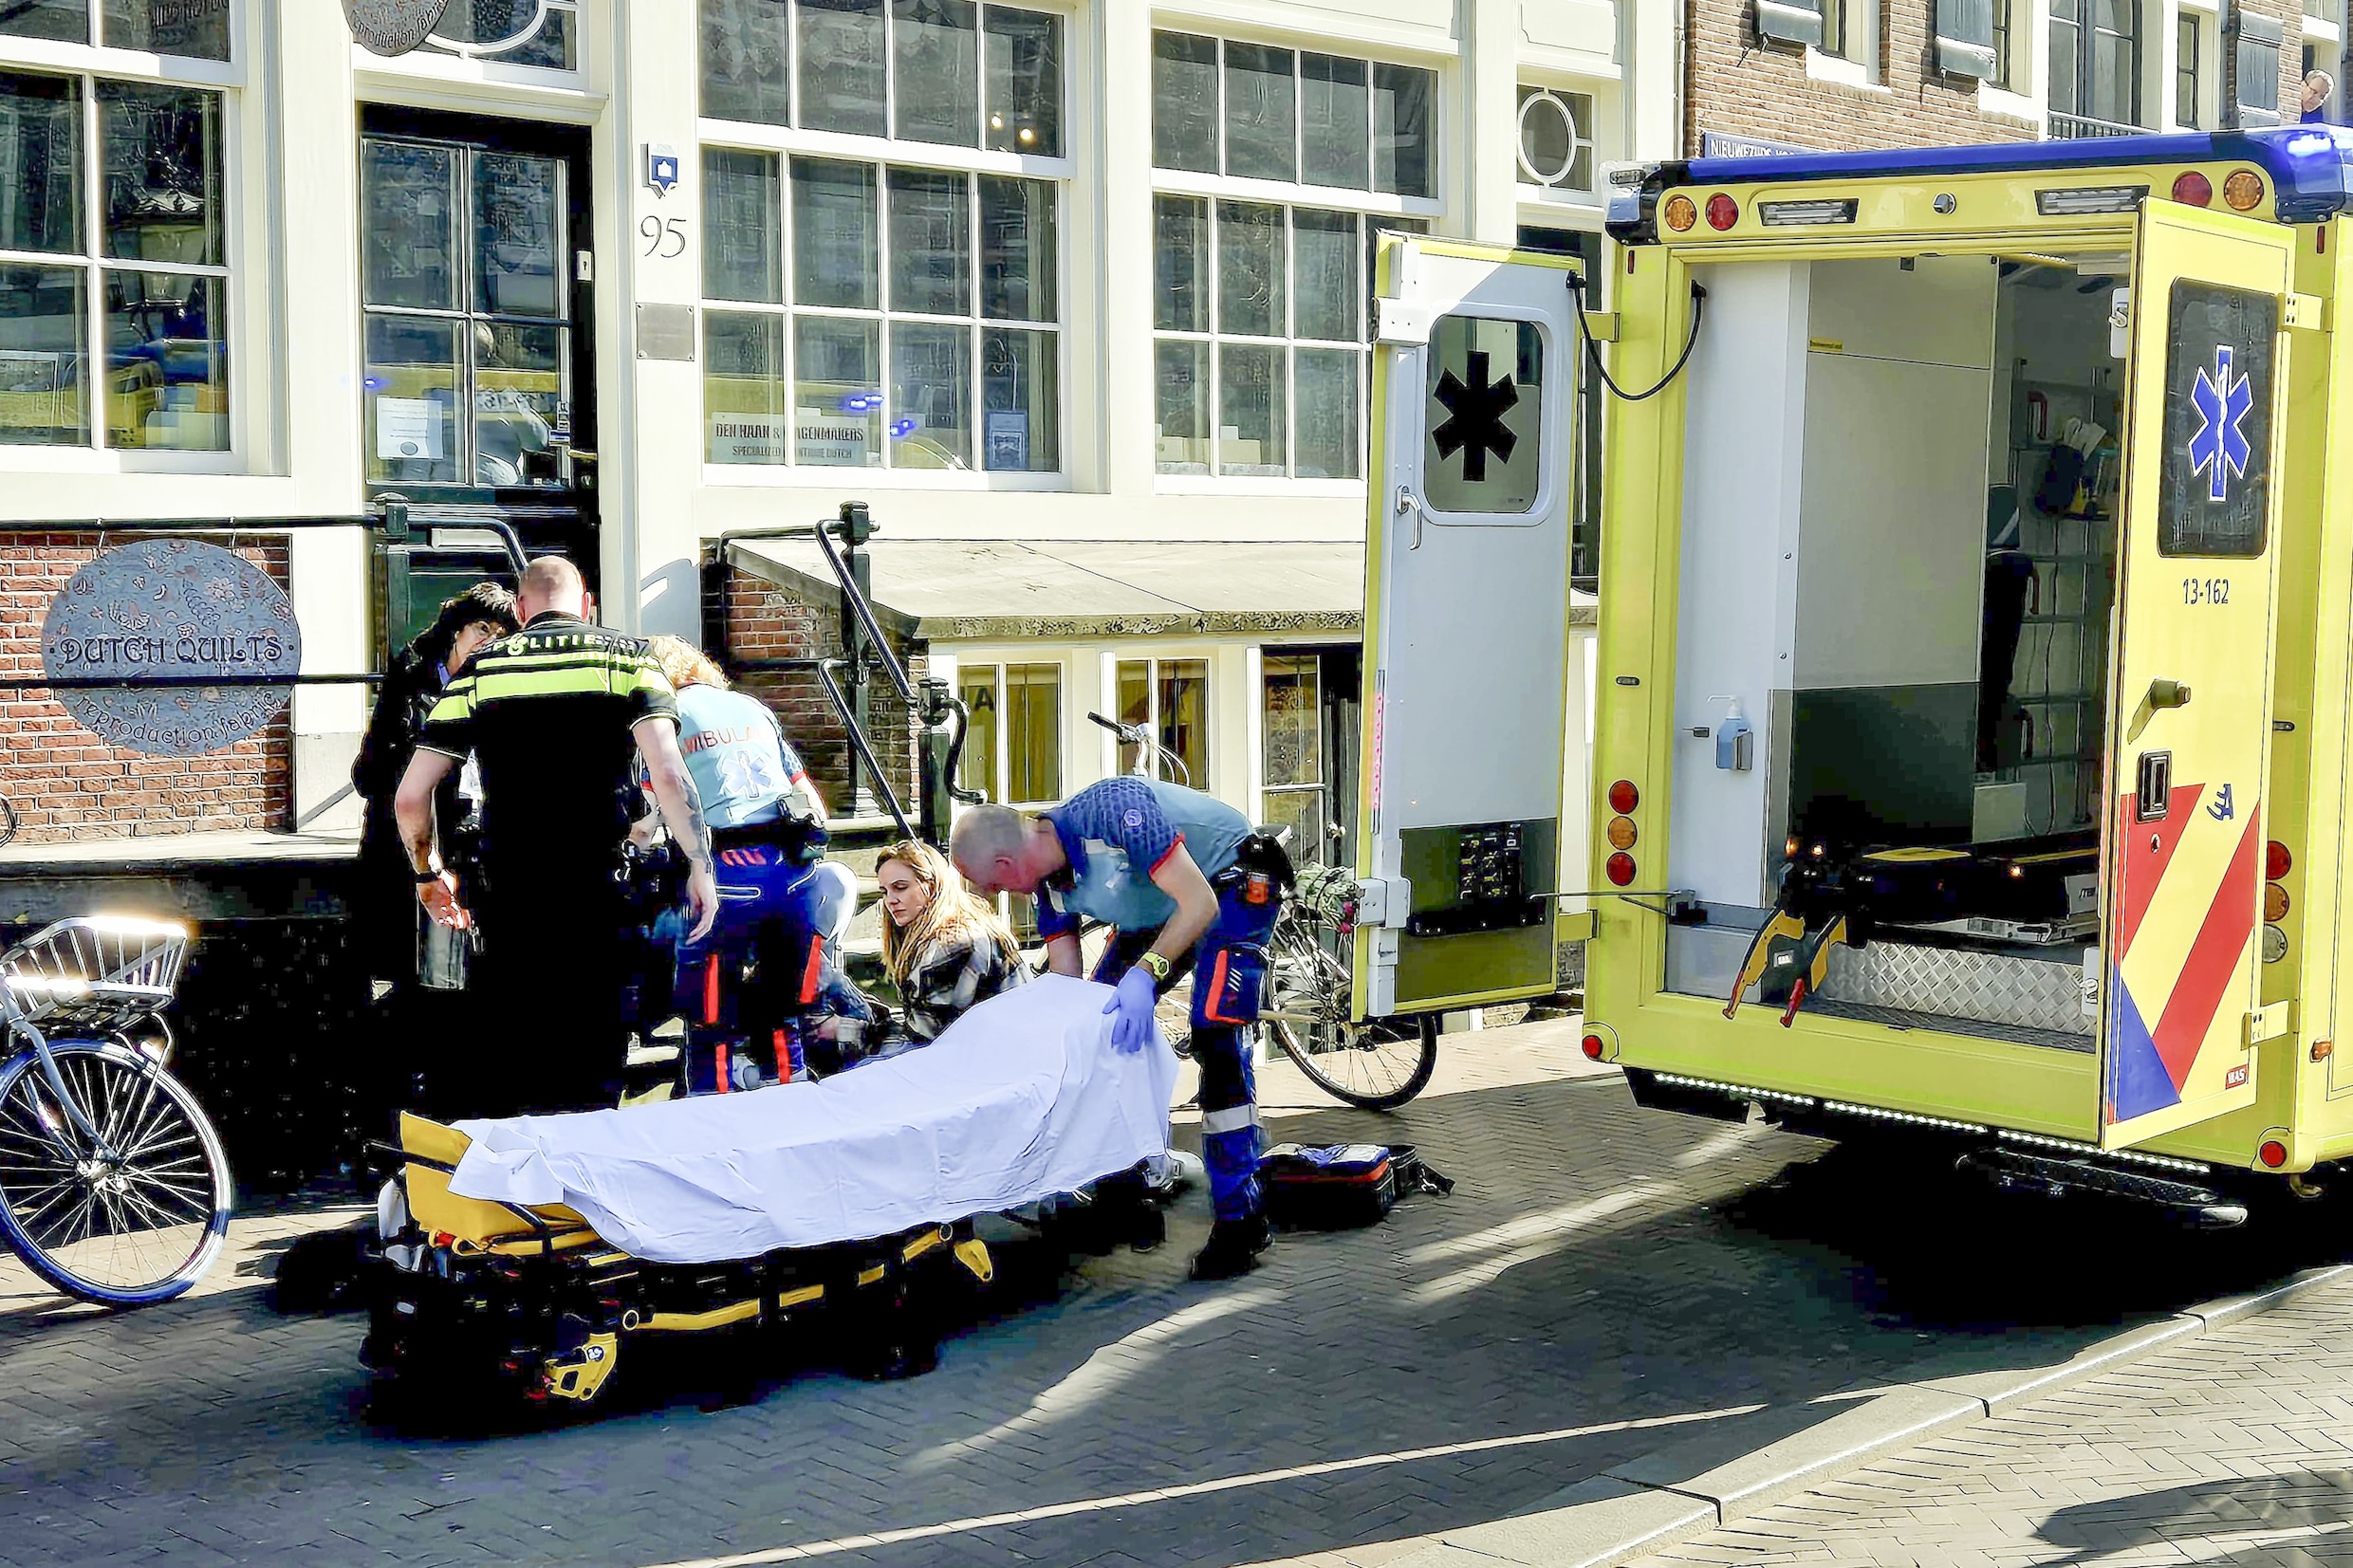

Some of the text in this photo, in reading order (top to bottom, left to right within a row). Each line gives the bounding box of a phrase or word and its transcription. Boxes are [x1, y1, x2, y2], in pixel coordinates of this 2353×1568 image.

[639, 215, 687, 258] 95
[716, 423, 736, 437] DEN
[739, 424, 769, 438] HAAN
[2183, 578, 2229, 604] 13-162
[60, 636, 283, 664] DUTCH QUILTS
[73, 695, 215, 745] reproduction
